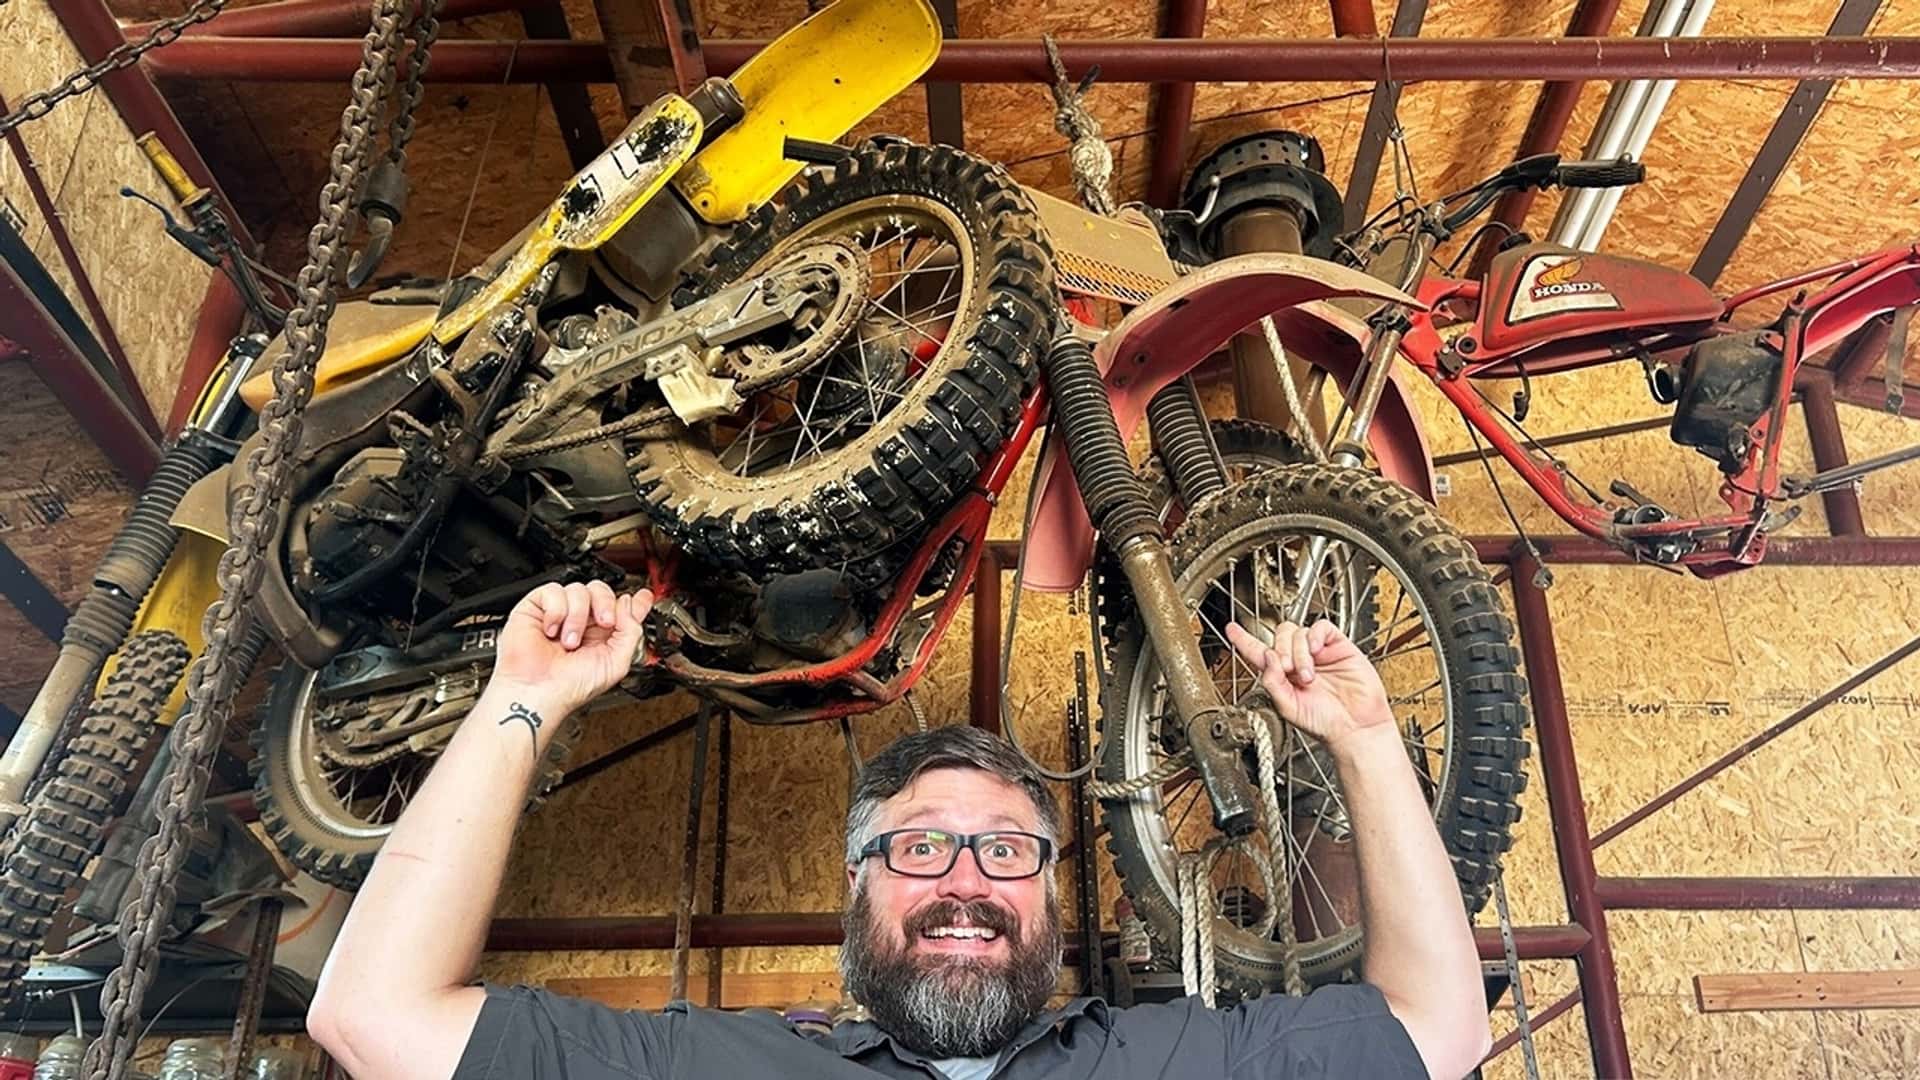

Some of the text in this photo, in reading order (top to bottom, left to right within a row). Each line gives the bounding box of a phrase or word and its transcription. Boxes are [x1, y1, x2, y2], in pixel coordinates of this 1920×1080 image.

[1534, 282, 1606, 298] HONDA
[572, 308, 702, 377] MONO-X
[461, 629, 499, 651] PR
